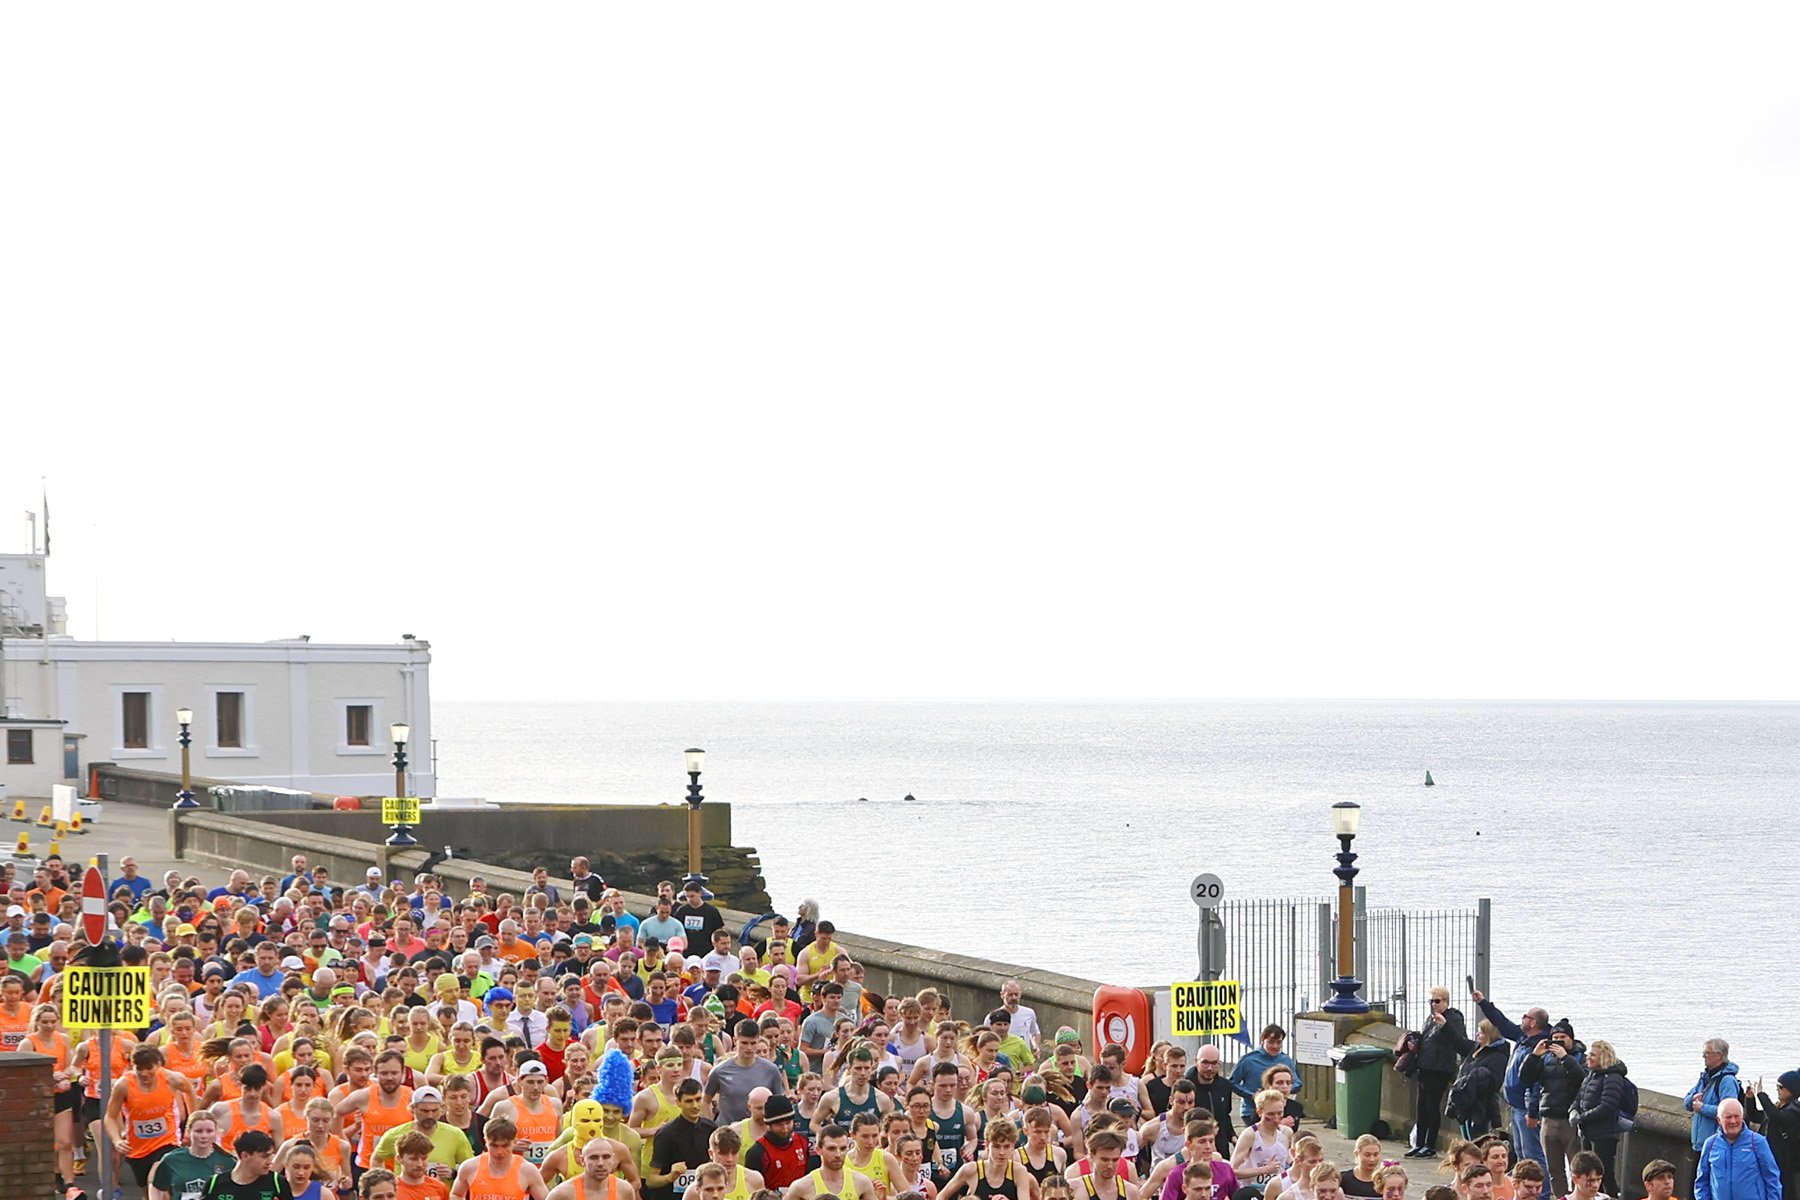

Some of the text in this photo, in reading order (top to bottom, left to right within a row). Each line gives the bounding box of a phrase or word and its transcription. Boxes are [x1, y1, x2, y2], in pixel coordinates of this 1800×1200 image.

[384, 799, 418, 810] CAUTION
[384, 811, 417, 822] RUNNERS
[1195, 883, 1220, 898] 20
[69, 971, 146, 996] CAUTION
[1175, 984, 1237, 1008] CAUTION
[69, 999, 143, 1023] RUNNERS
[1176, 1008, 1236, 1032] RUNNERS
[137, 1122, 162, 1136] 133
[678, 1175, 696, 1187] 08
